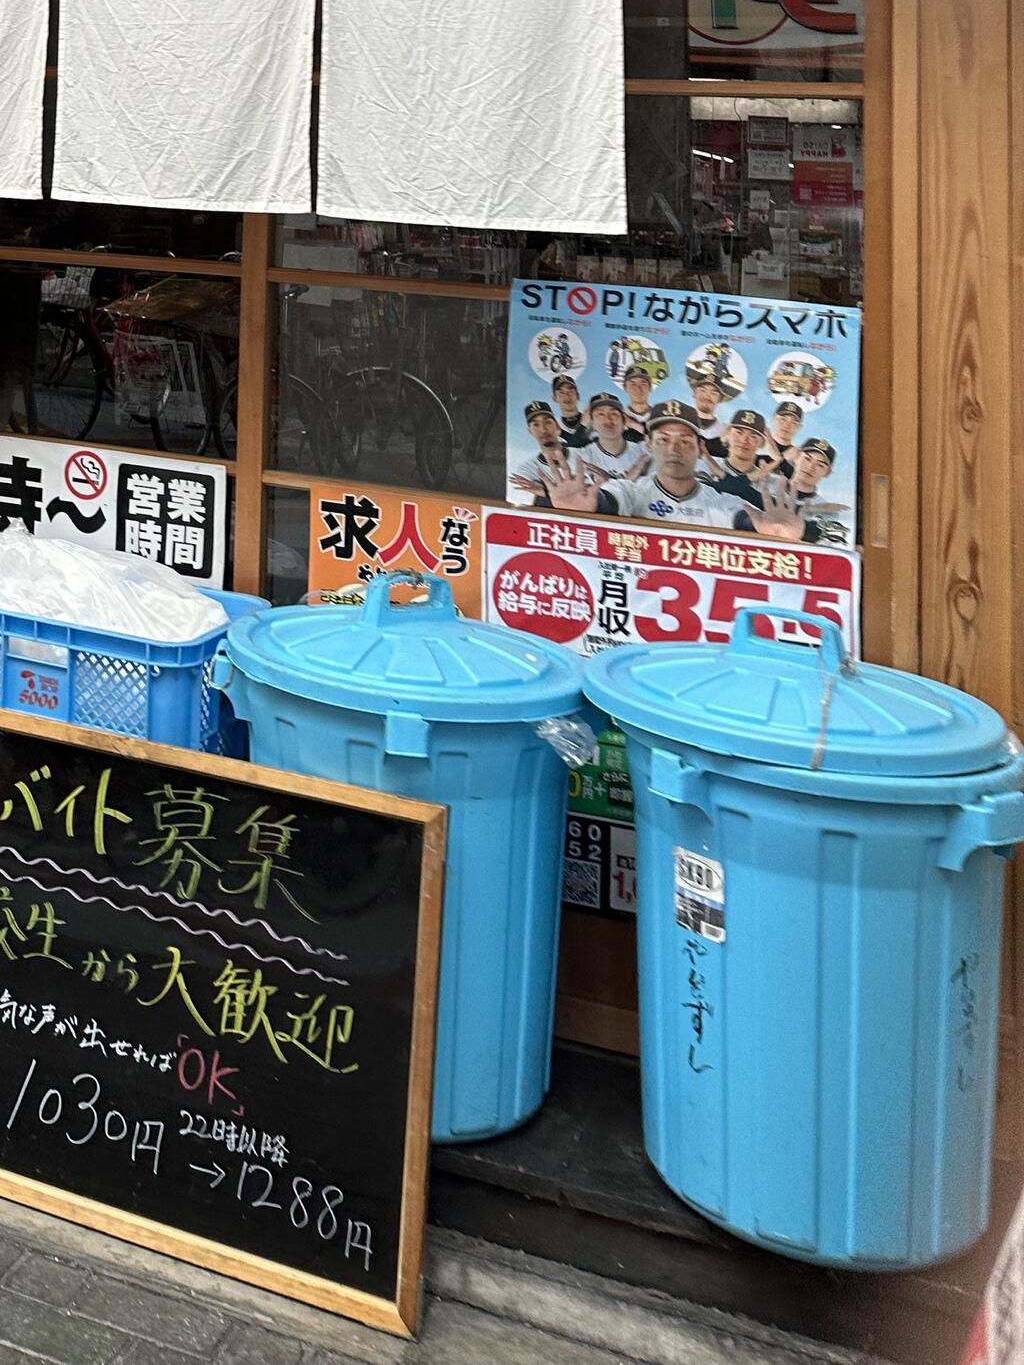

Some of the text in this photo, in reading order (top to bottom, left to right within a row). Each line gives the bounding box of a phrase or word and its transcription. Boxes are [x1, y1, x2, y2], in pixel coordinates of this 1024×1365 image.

[125, 472, 207, 524] 営業
[320, 495, 470, 574] 求人 なう
[527, 521, 599, 556] 正社員
[658, 538, 813, 580] 1分単位支給!
[497, 590, 592, 623] 給与に反映
[499, 569, 588, 601] がんばりは
[597, 580, 631, 637] 月収
[6, 1058, 164, 1176] 1030円
[179, 1109, 291, 1167] 22時以降
[237, 1160, 373, 1271] 1288円
